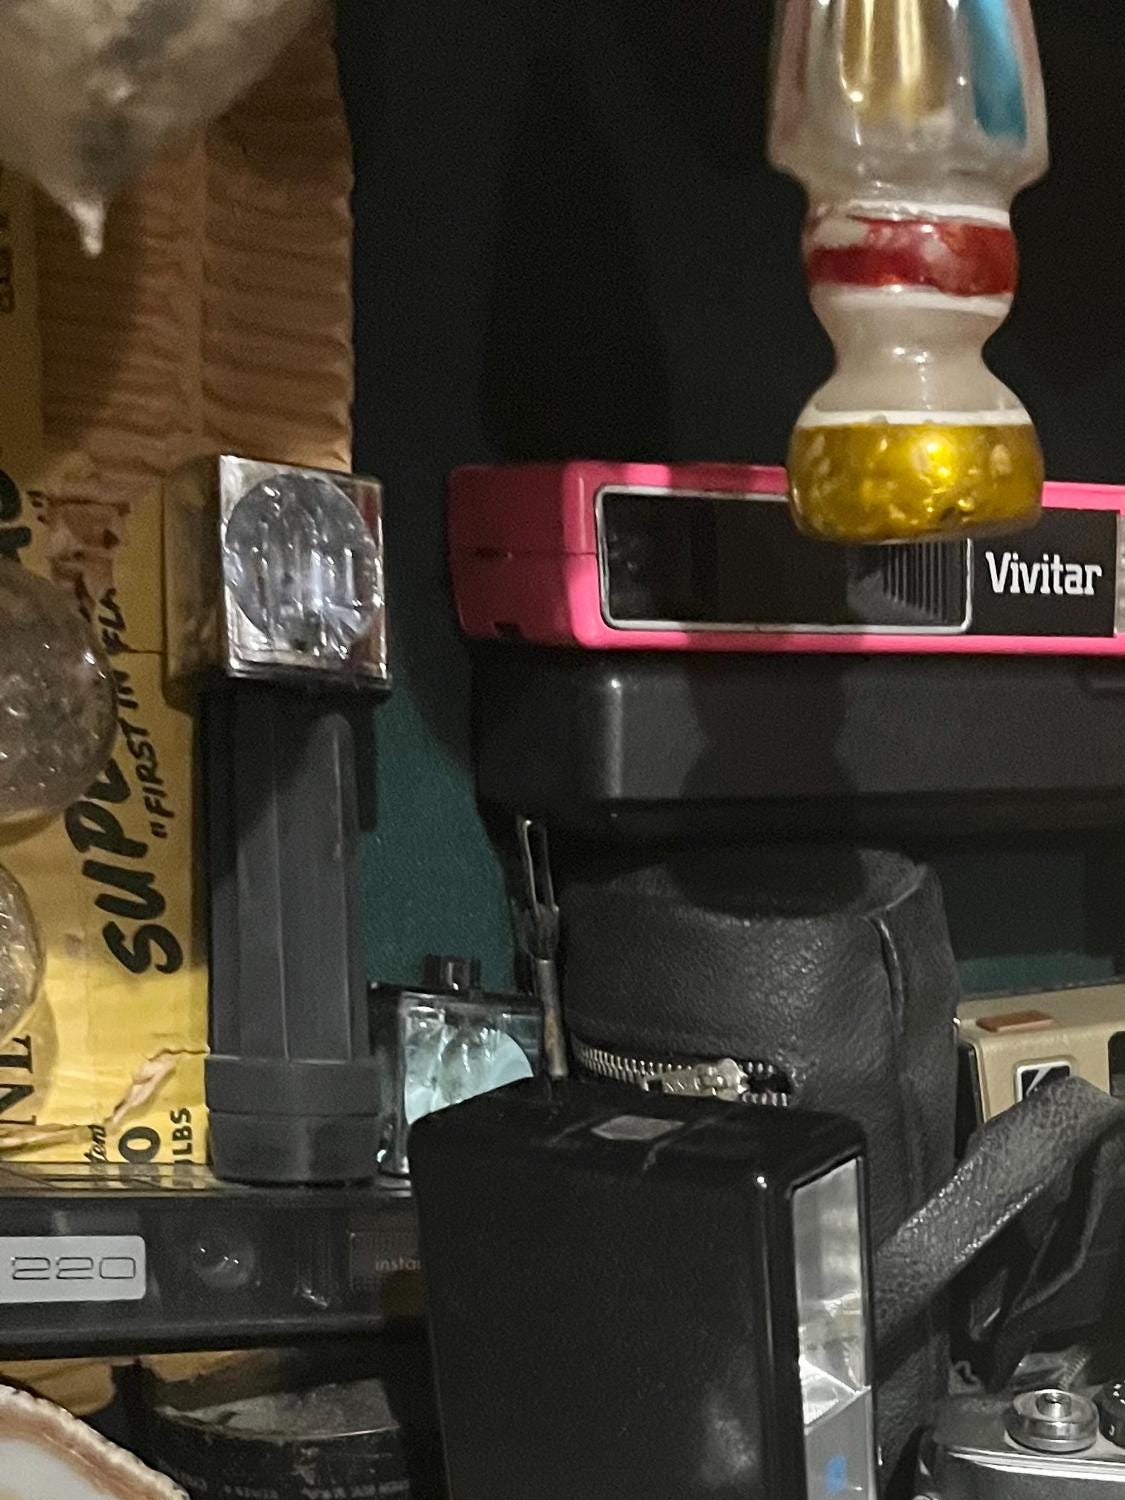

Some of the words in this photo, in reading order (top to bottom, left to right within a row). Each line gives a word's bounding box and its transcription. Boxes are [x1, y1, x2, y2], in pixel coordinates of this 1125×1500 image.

[985, 551, 1103, 596] Vivitar
[11, 1256, 136, 1281] 220
[374, 1255, 421, 1272] insta
